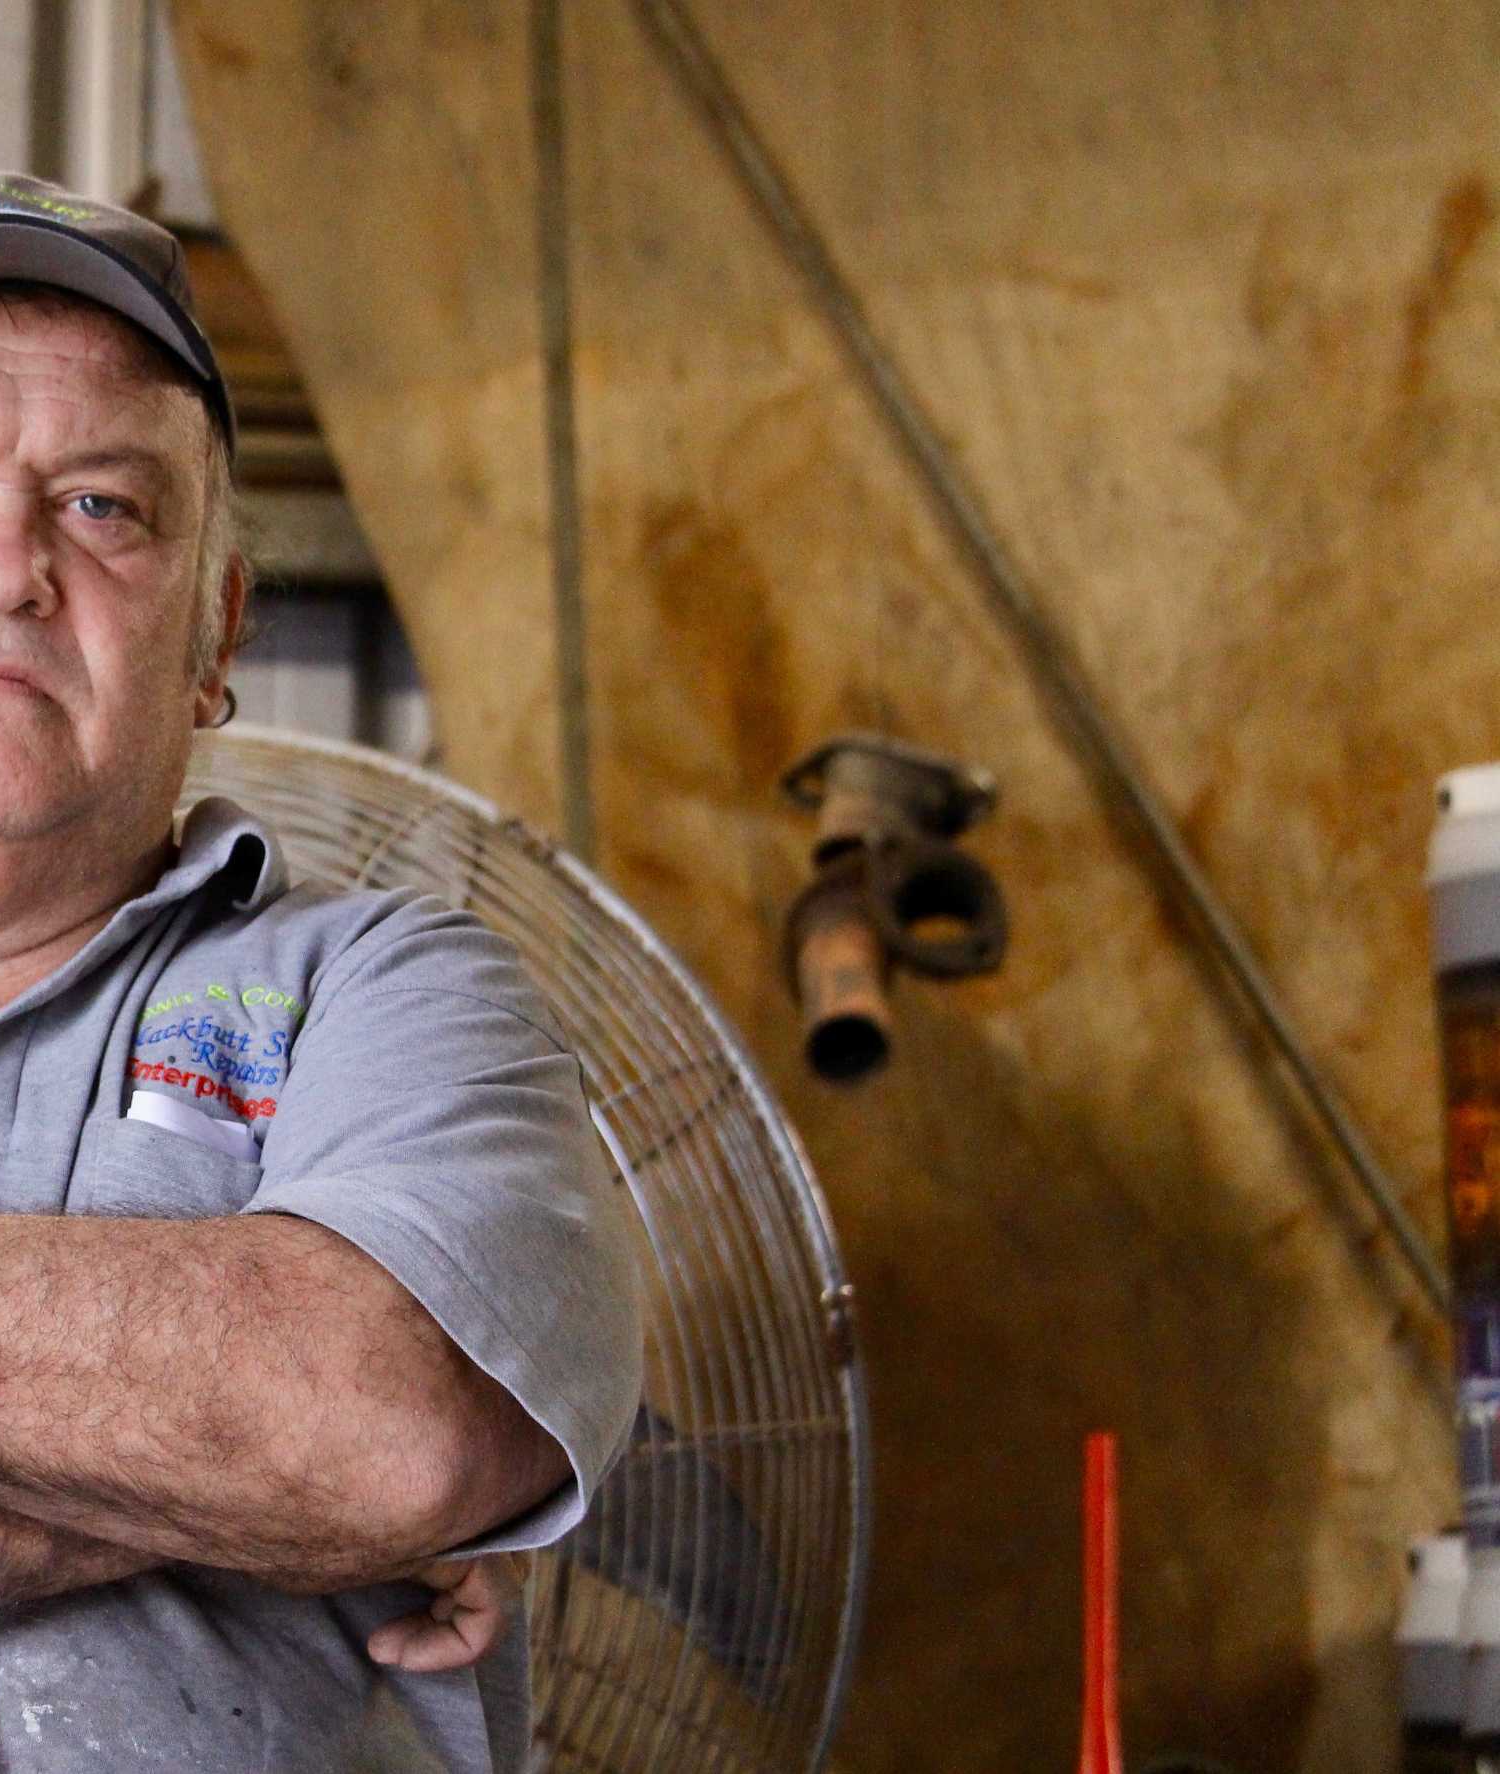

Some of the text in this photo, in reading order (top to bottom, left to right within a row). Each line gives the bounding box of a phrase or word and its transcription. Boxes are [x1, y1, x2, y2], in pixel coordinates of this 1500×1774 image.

[206, 984, 229, 1001] &
[136, 1015, 290, 1058] lackbutt S
[190, 1041, 280, 1086] Repairs
